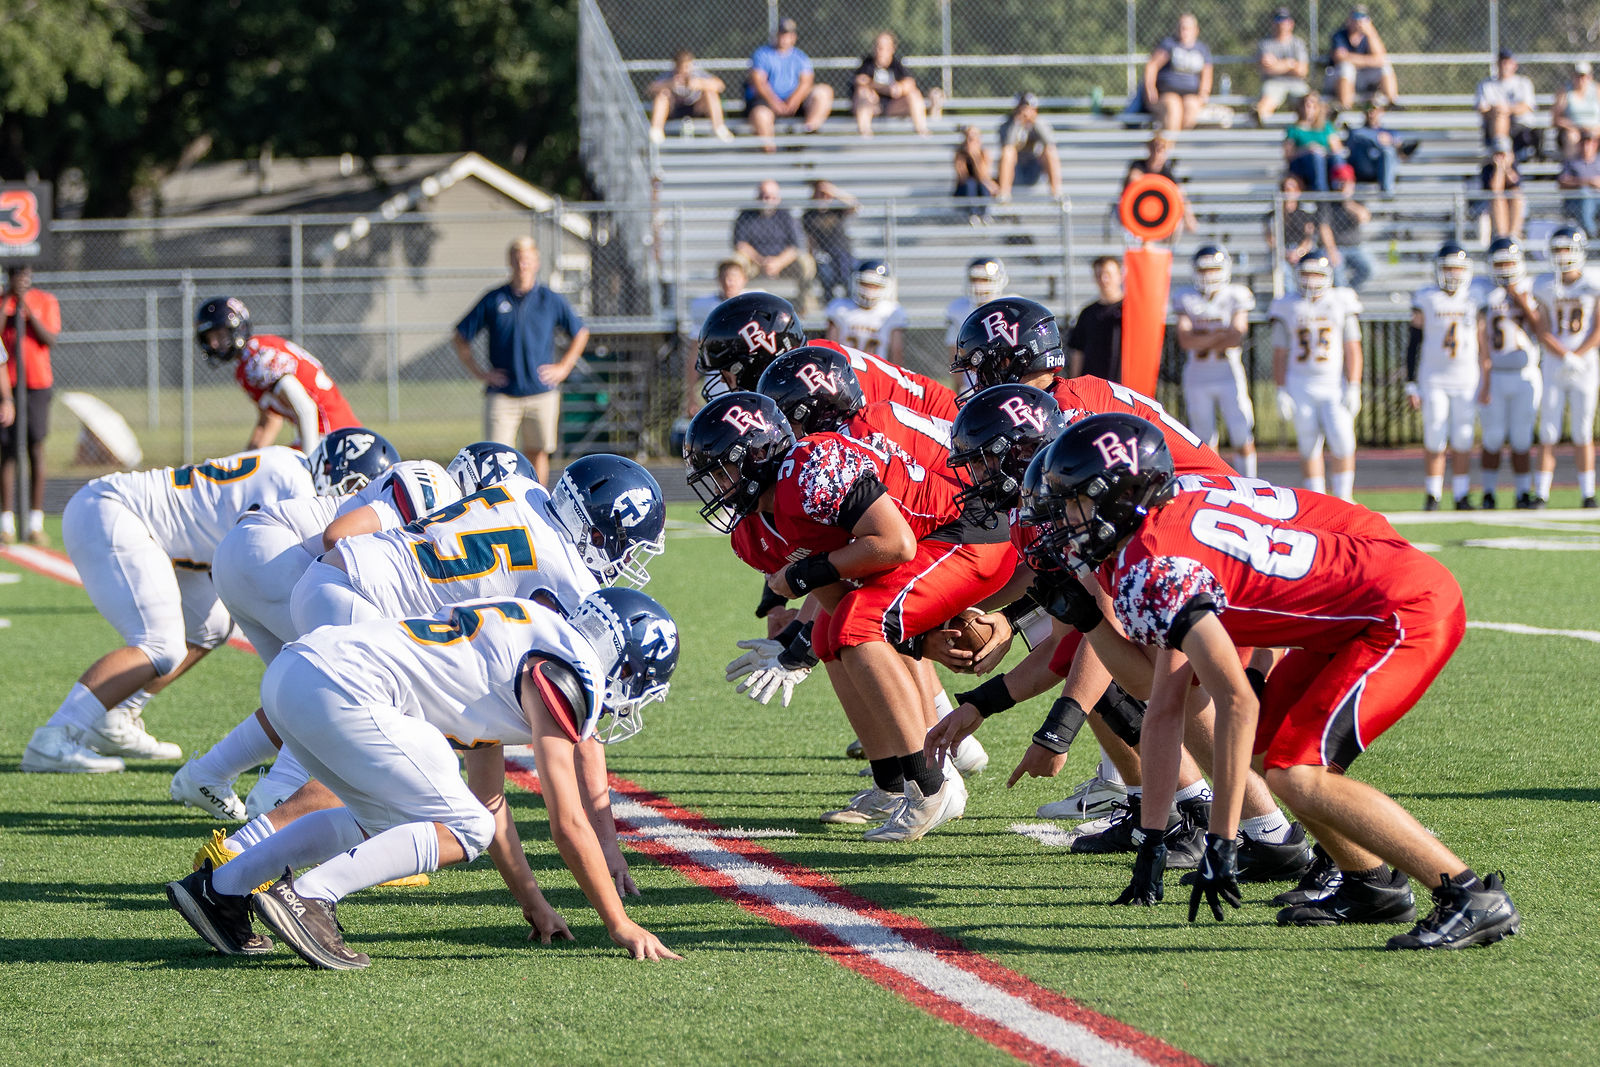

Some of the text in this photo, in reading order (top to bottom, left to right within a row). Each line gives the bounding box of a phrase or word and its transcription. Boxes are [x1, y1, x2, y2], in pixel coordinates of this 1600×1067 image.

[0, 190, 41, 245] 3
[1442, 321, 1458, 358] 4
[1046, 354, 1065, 368] Ridd
[573, 502, 587, 523] TITAN
[199, 786, 239, 819] BATTLE
[277, 884, 307, 917] HOKA
